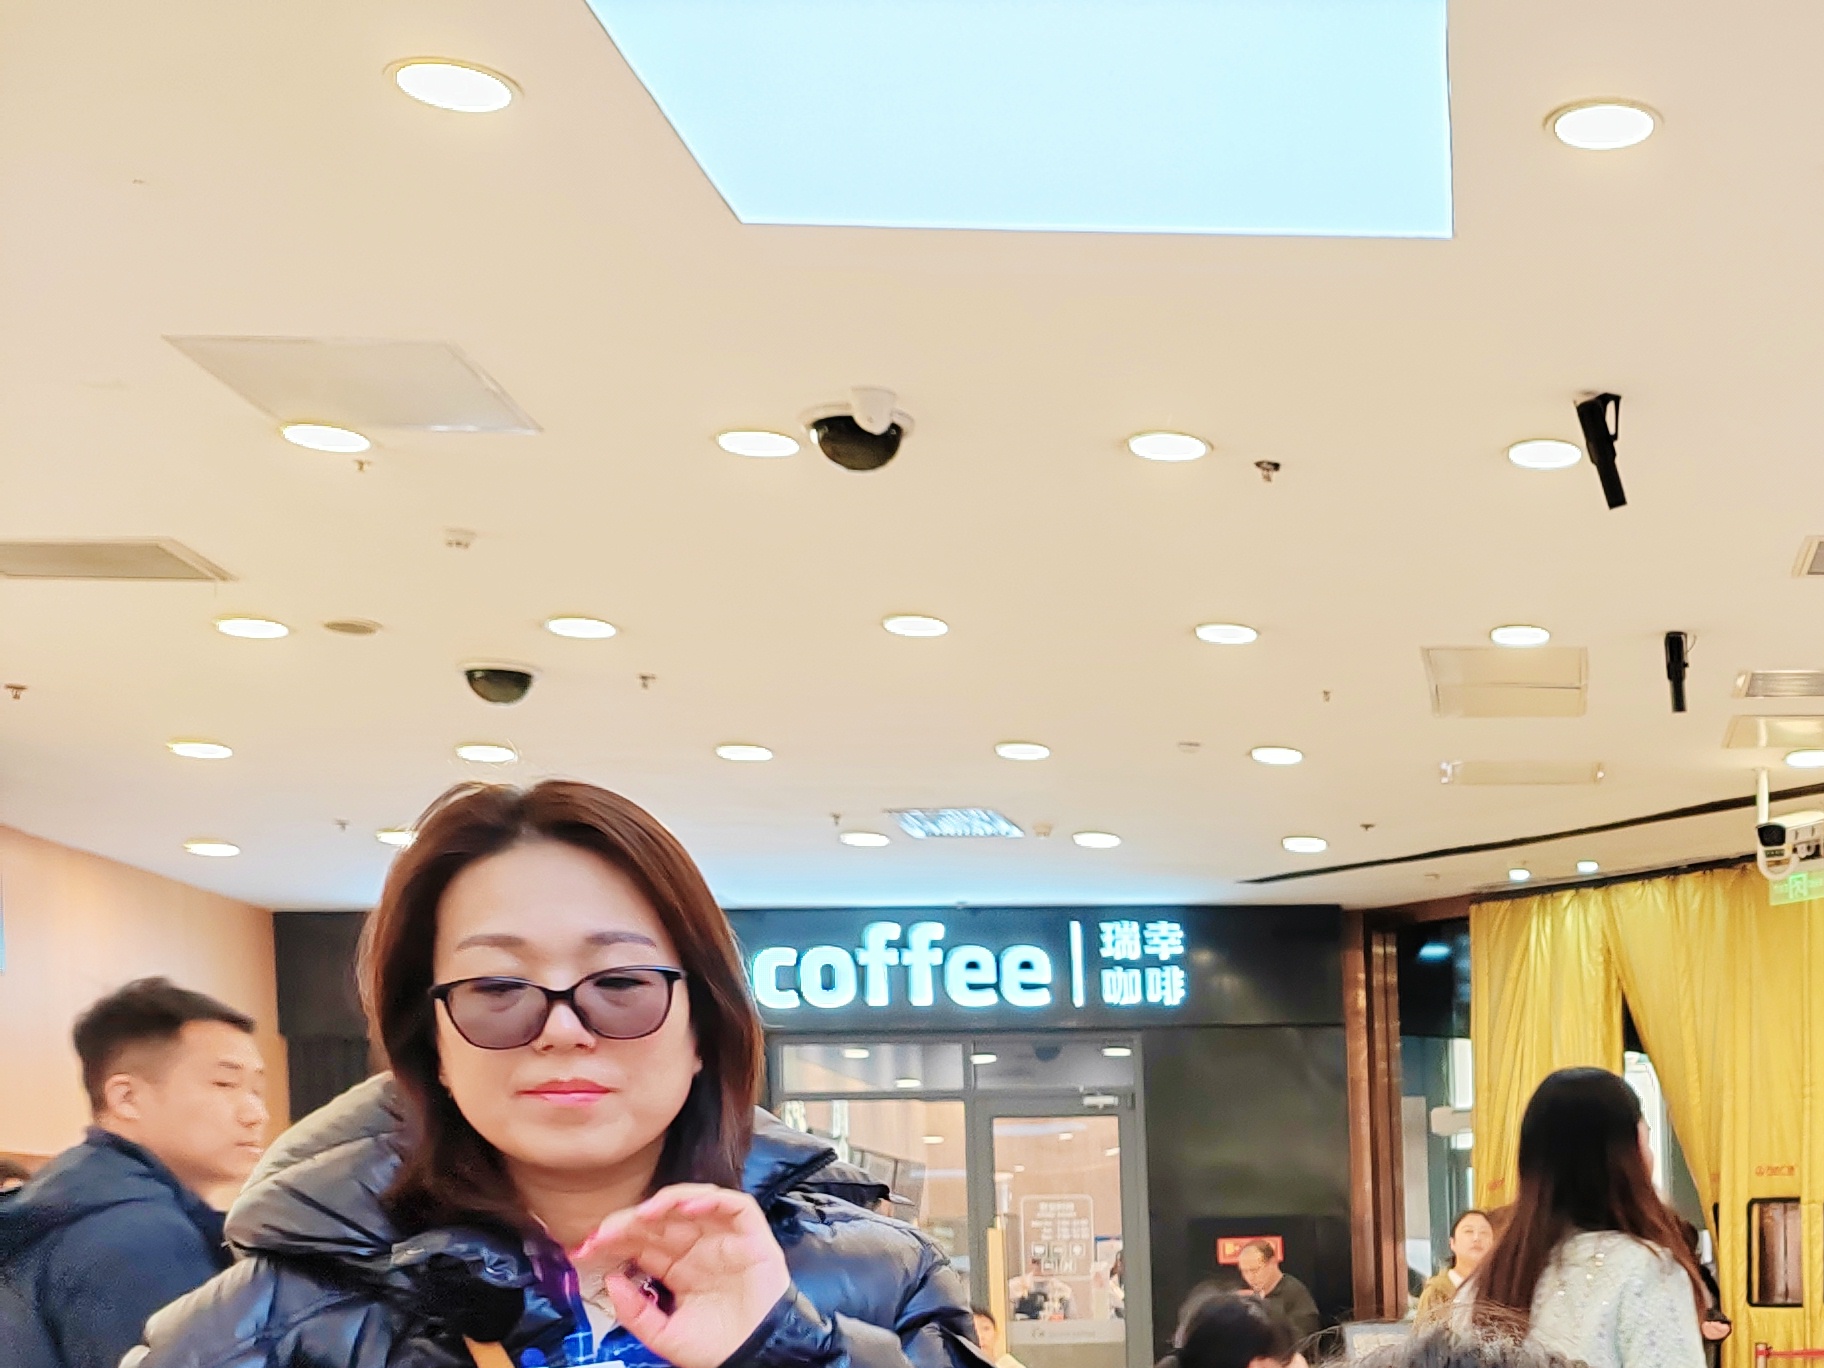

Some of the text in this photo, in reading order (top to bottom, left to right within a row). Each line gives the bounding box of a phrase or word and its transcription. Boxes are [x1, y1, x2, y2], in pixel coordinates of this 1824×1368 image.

[1099, 920, 1184, 961] 瑞幸
[752, 920, 1053, 1009] coffee
[1100, 964, 1186, 1006] 咖啡
